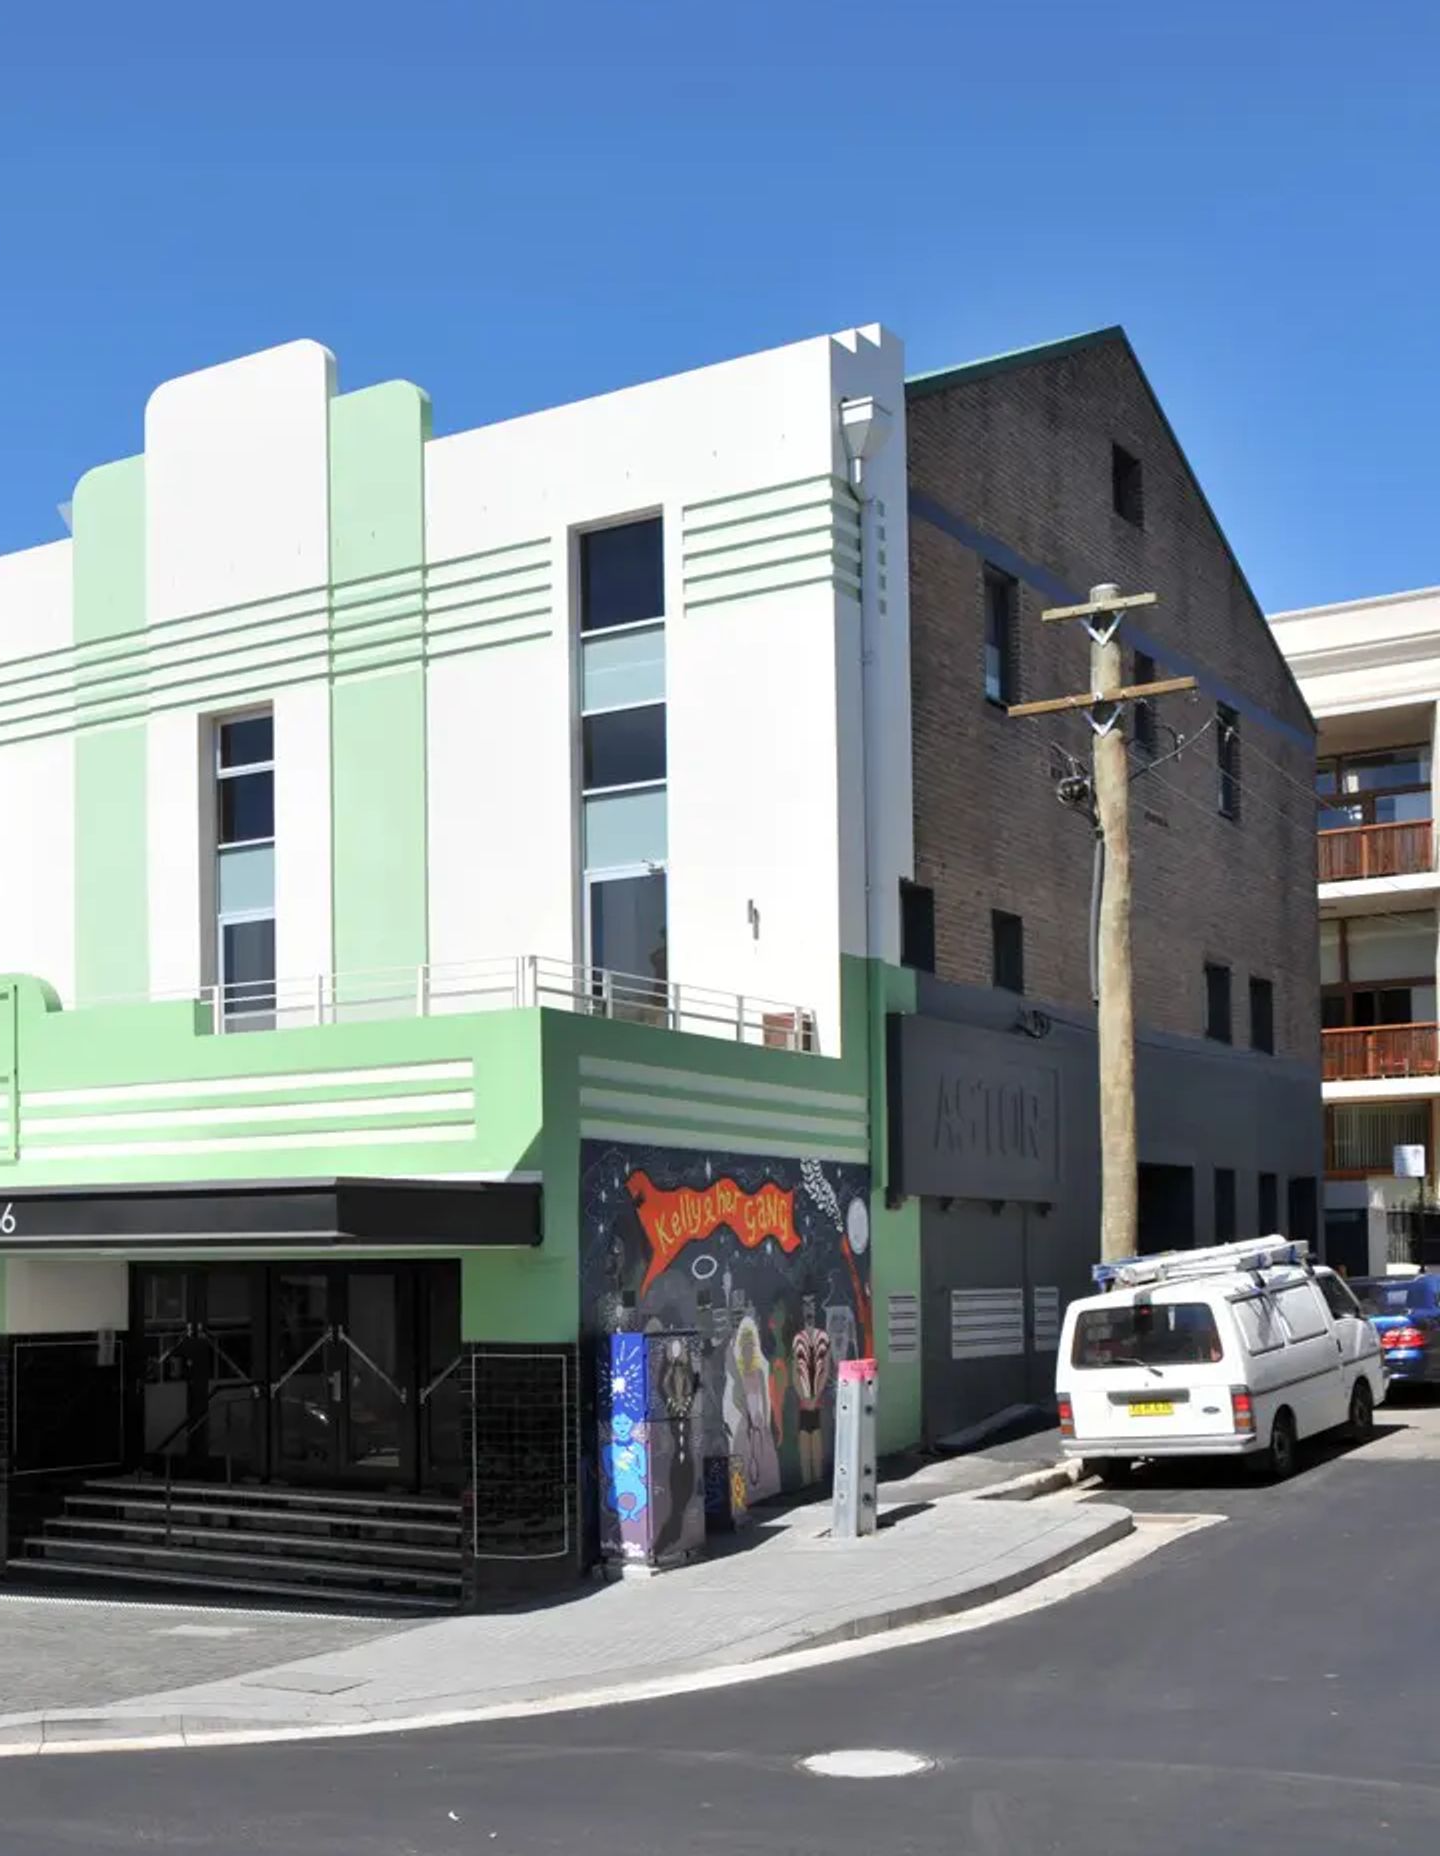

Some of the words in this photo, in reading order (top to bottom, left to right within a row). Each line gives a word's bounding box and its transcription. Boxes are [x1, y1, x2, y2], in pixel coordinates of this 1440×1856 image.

[934, 1072, 1039, 1160] ASTOR
[655, 1193, 702, 1254] Kelly
[715, 1177, 743, 1215] her
